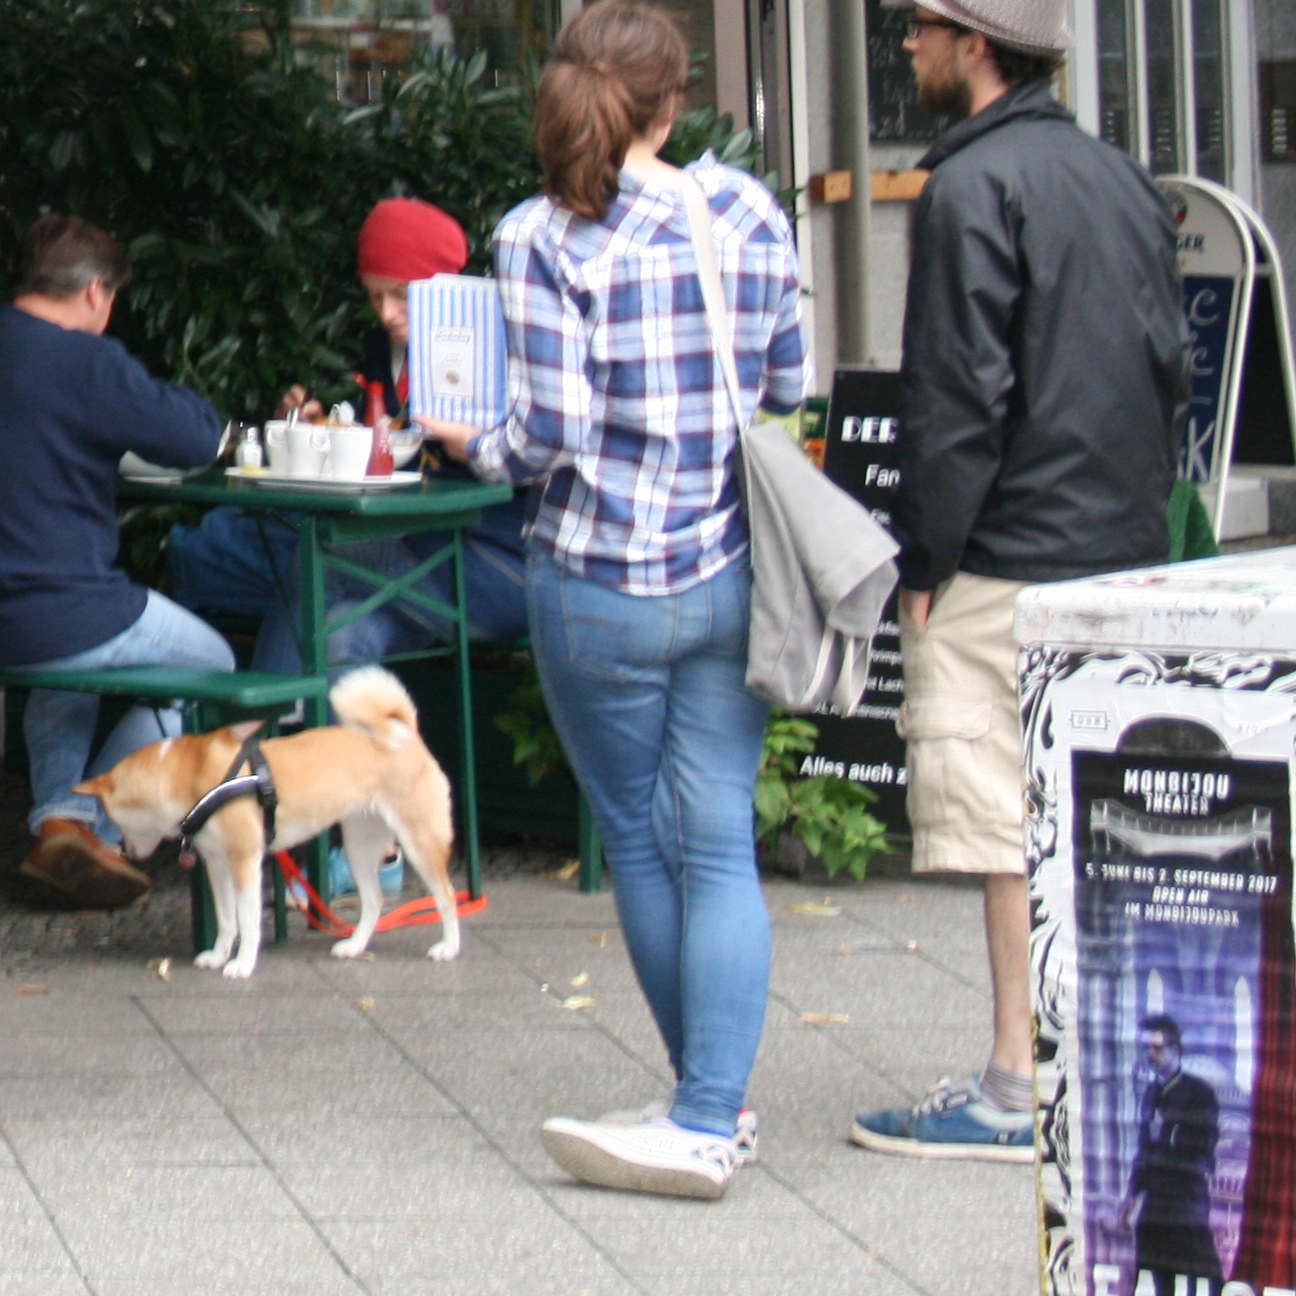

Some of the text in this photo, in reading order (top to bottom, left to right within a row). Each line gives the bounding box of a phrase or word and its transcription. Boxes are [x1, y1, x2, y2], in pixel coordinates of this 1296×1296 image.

[799, 755, 844, 780] Alles
[848, 762, 893, 784] auch
[1124, 767, 1230, 800] MONBIJOU
[1144, 792, 1210, 815] THEATER
[1101, 863, 1130, 879] JUNI
[1133, 866, 1154, 883] BIS
[1174, 868, 1245, 890] SEPTEMBER
[1248, 874, 1277, 895] 2017
[1152, 884, 1210, 905] OPEN AIR
[1125, 901, 1240, 927] IM MONBIJOUPARK
